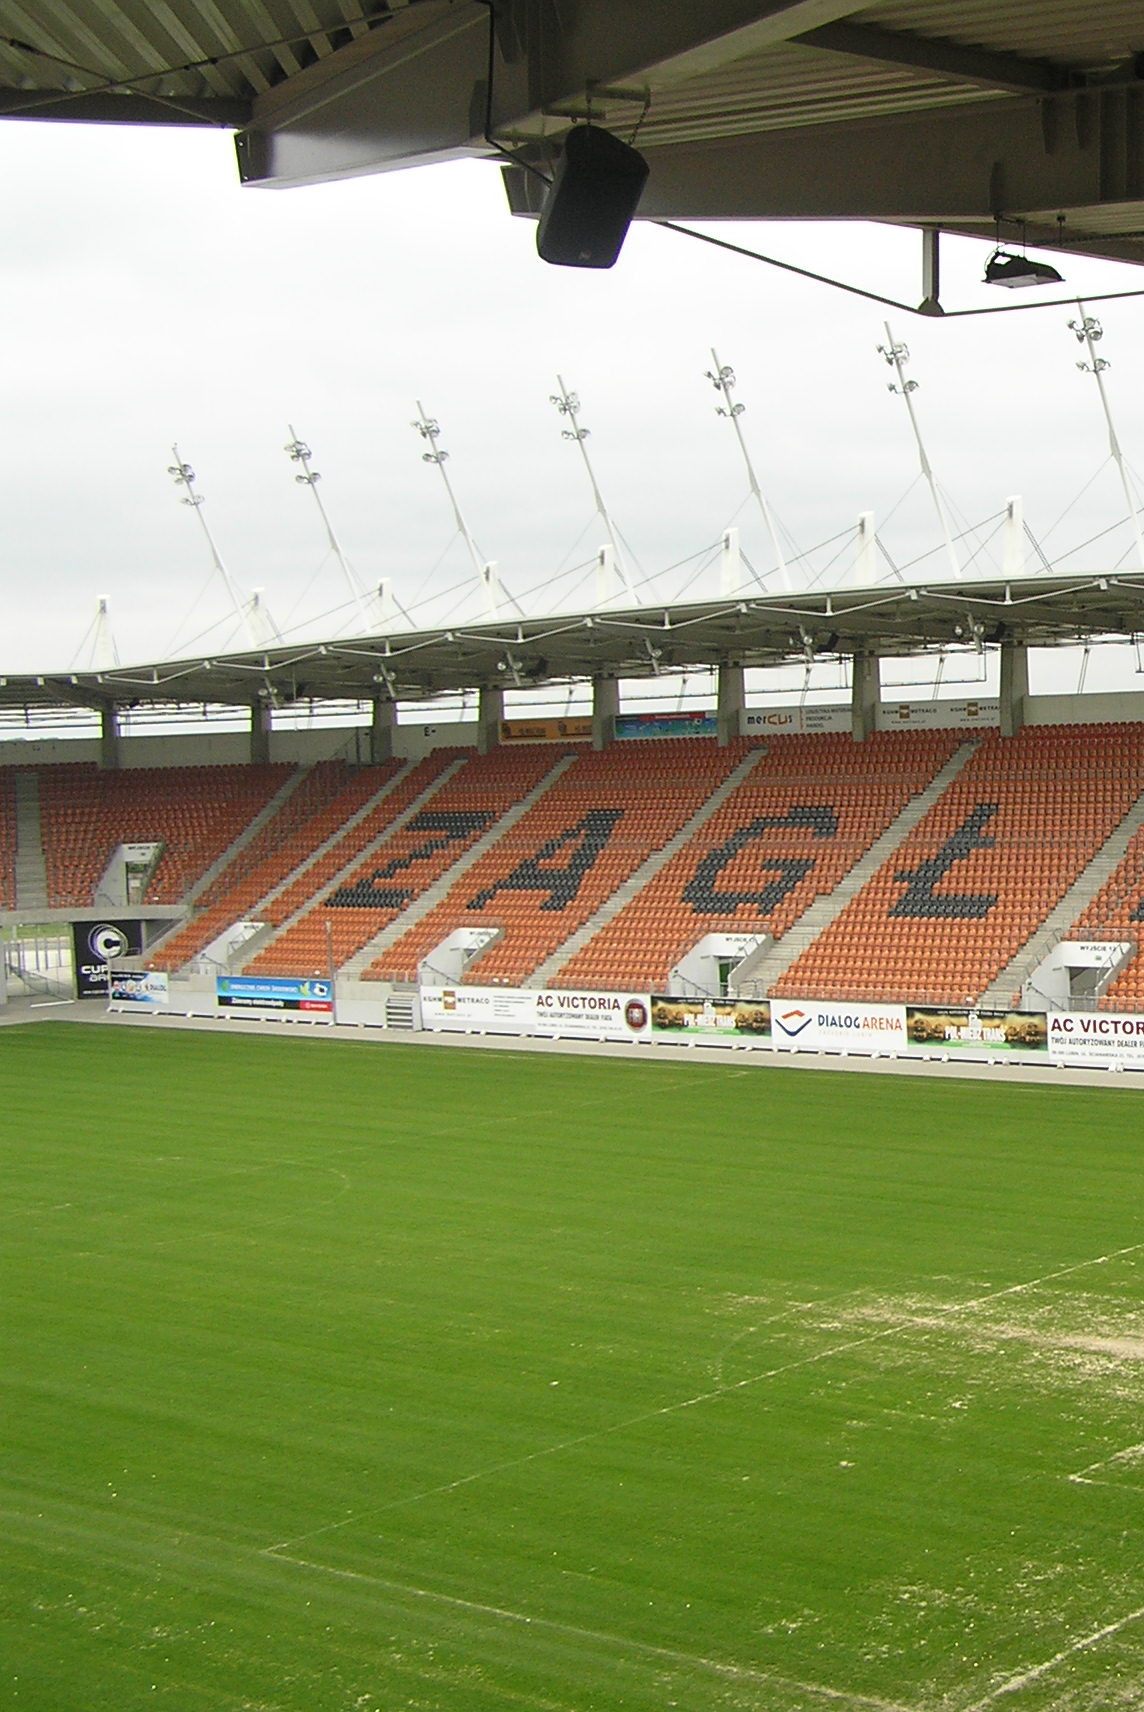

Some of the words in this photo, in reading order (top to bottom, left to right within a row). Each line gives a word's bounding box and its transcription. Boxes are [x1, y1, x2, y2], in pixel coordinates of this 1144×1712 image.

[536, 994, 553, 1008] AC
[557, 995, 621, 1010] VICTORIA
[817, 1014, 860, 1029] DIALOG
[862, 1016, 903, 1031] ARENA
[1051, 1018, 1074, 1032] AC
